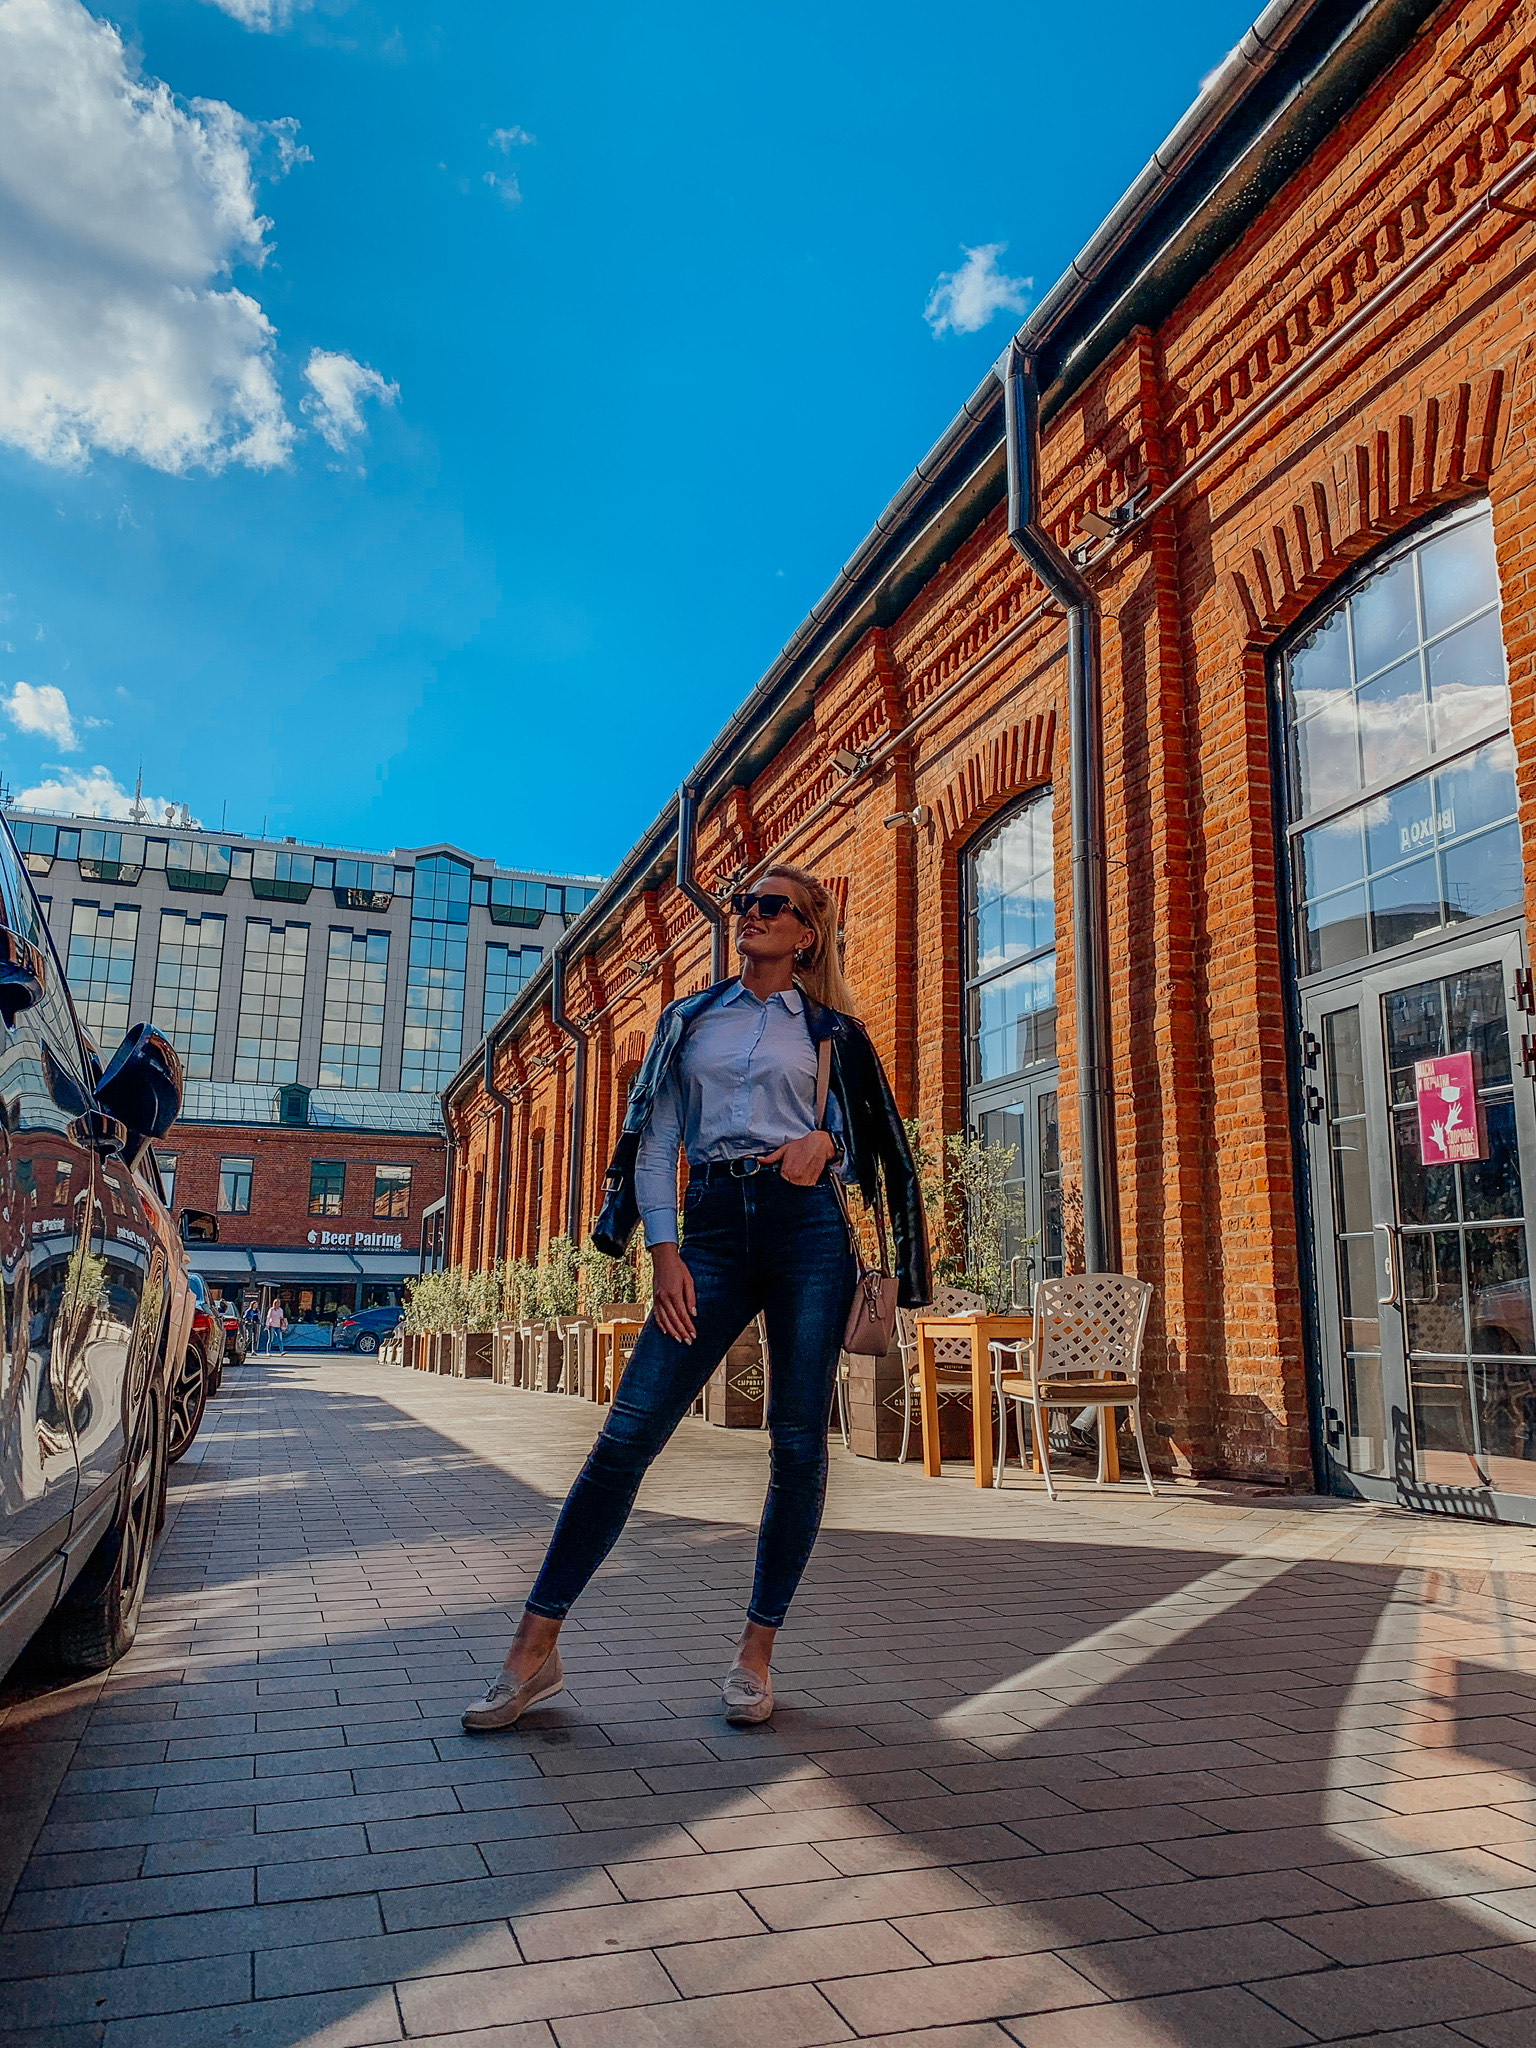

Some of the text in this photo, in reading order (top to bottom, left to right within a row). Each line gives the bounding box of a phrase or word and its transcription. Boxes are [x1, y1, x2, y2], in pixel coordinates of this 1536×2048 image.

[1418, 1062, 1436, 1078] МАСКА
[1447, 1126, 1475, 1145] ЗДОРОВЬЕ
[320, 1230, 402, 1249] Beer Pairing
